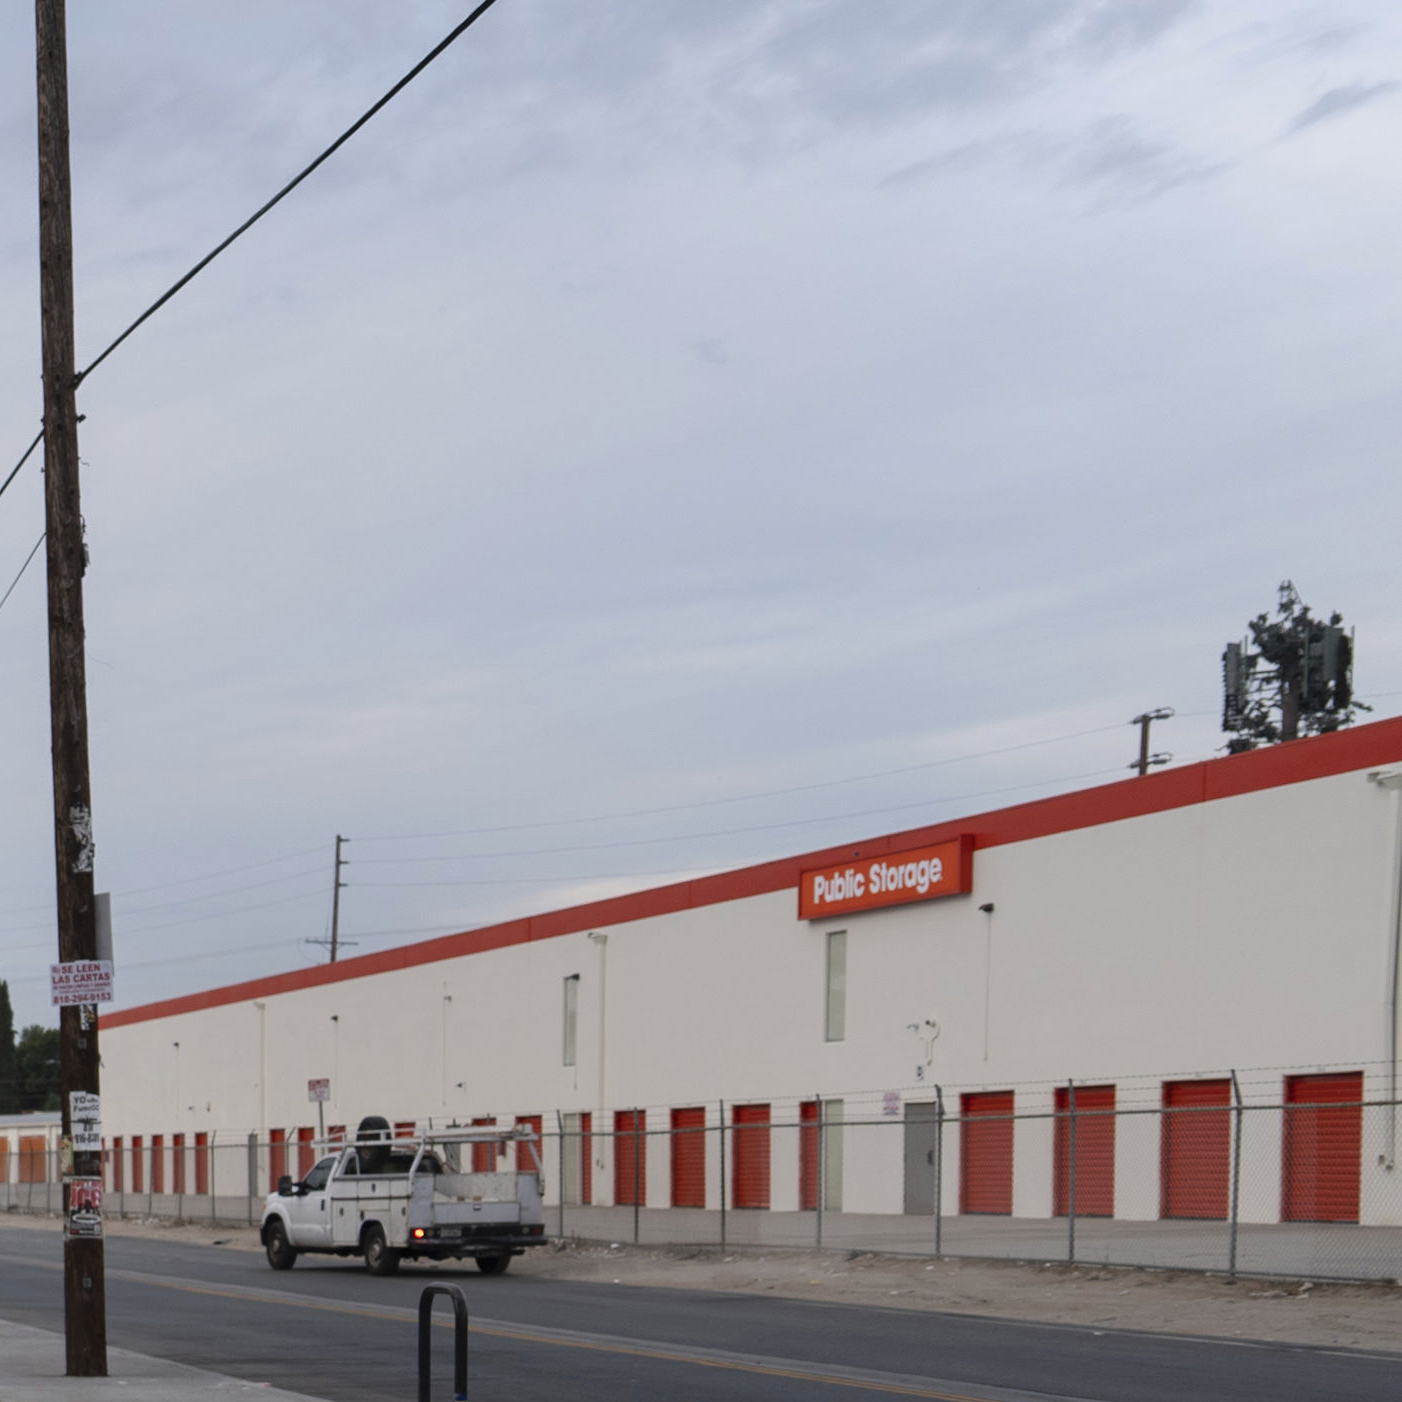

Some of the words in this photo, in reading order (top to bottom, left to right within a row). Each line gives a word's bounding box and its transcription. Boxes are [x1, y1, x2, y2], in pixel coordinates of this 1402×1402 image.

[814, 868, 865, 904] Public
[869, 857, 943, 894] Storage
[61, 965, 74, 975] SE
[76, 963, 101, 973] LEEN
[52, 975, 71, 985] LAS
[73, 972, 111, 983] CARTAS
